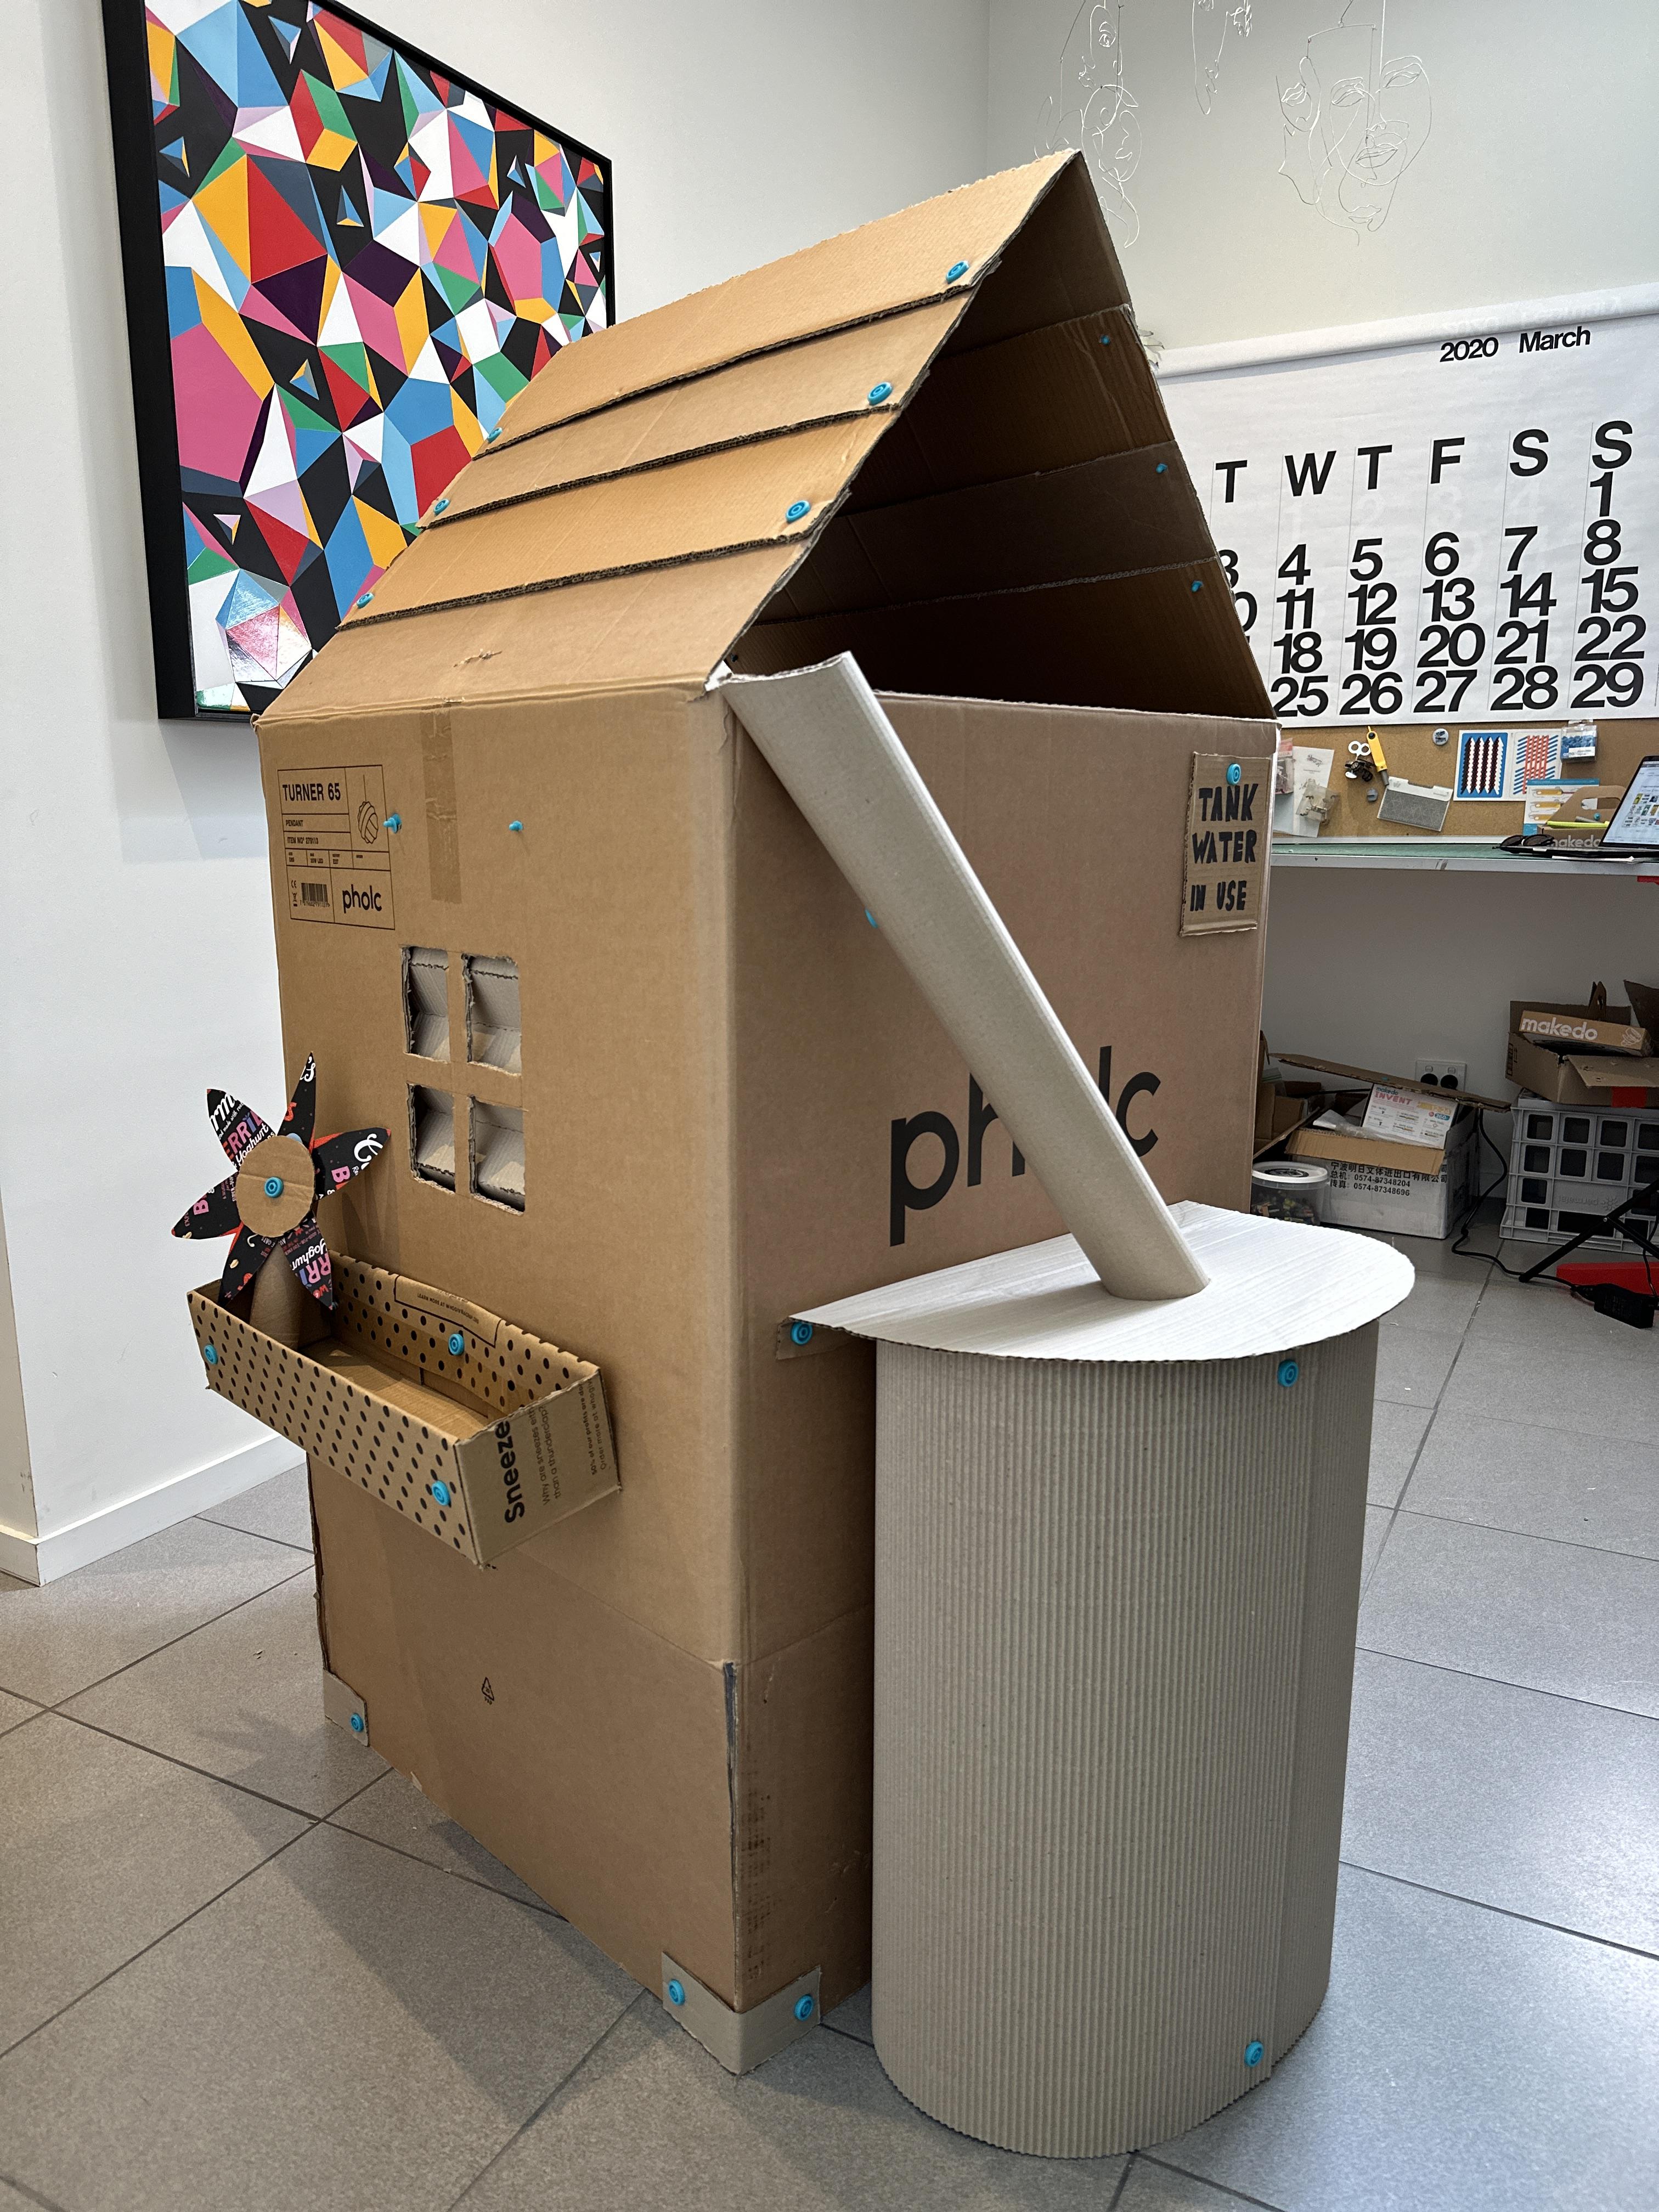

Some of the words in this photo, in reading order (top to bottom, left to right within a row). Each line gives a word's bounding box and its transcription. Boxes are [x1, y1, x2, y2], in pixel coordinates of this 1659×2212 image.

[1440, 337, 1498, 362] 2020
[1519, 326, 1590, 353] March
[1215, 460, 1247, 503] T
[1285, 451, 1336, 496] W
[1358, 445, 1392, 490] T
[1430, 437, 1465, 484] F
[1510, 428, 1549, 476] S
[1592, 420, 1633, 469] S
[1589, 471, 1613, 517] 1
[1278, 544, 1311, 585] 4
[1350, 538, 1383, 581] 5
[1425, 532, 1459, 577] 6
[1505, 526, 1538, 571] 7
[1583, 519, 1621, 566] 8
[1234, 591, 1257, 631] 0
[1276, 588, 1314, 630] 11
[1348, 583, 1397, 626] 12
[1423, 578, 1475, 622] 13
[1500, 572, 1557, 618] 14
[1581, 566, 1639, 613] 15
[1273, 631, 1323, 674] 18
[1345, 628, 1397, 670] 19
[1417, 623, 1485, 668] 20
[1494, 619, 1549, 664] 21
[1575, 614, 1646, 661] 22
[1271, 675, 1329, 717] 25
[1339, 672, 1403, 715] 26
[1413, 669, 1477, 713] 27
[1491, 665, 1559, 710] 28
[1571, 662, 1644, 708] 29
[282, 783, 324, 802] TURNER
[328, 783, 341, 801] 65
[1199, 783, 1259, 822] TANK
[1192, 829, 1257, 864] WATER
[342, 884, 382, 914] pholc
[1190, 884, 1206, 911] IN
[1216, 880, 1247, 911] USE
[1521, 1017, 1598, 1041] makedo
[1374, 1091, 1413, 1105] INVENT
[235, 1122, 269, 1166] Yoghurt
[889, 1045, 1161, 1247] phlc
[1353, 1183, 1410, 1197] 0574-87348696
[1354, 1174, 1410, 1188] 0574-87348204
[417, 1293, 429, 1301] LEARN
[583, 1411, 592, 1435] profits
[592, 1412, 599, 1421] at
[532, 1426, 544, 1464] sneezes
[538, 1406, 556, 1466] thunderclap?
[494, 1420, 525, 1523] Sneeze
[599, 1447, 607, 1470] Order
[542, 1483, 551, 1506] Why
[552, 1475, 562, 1499] than
